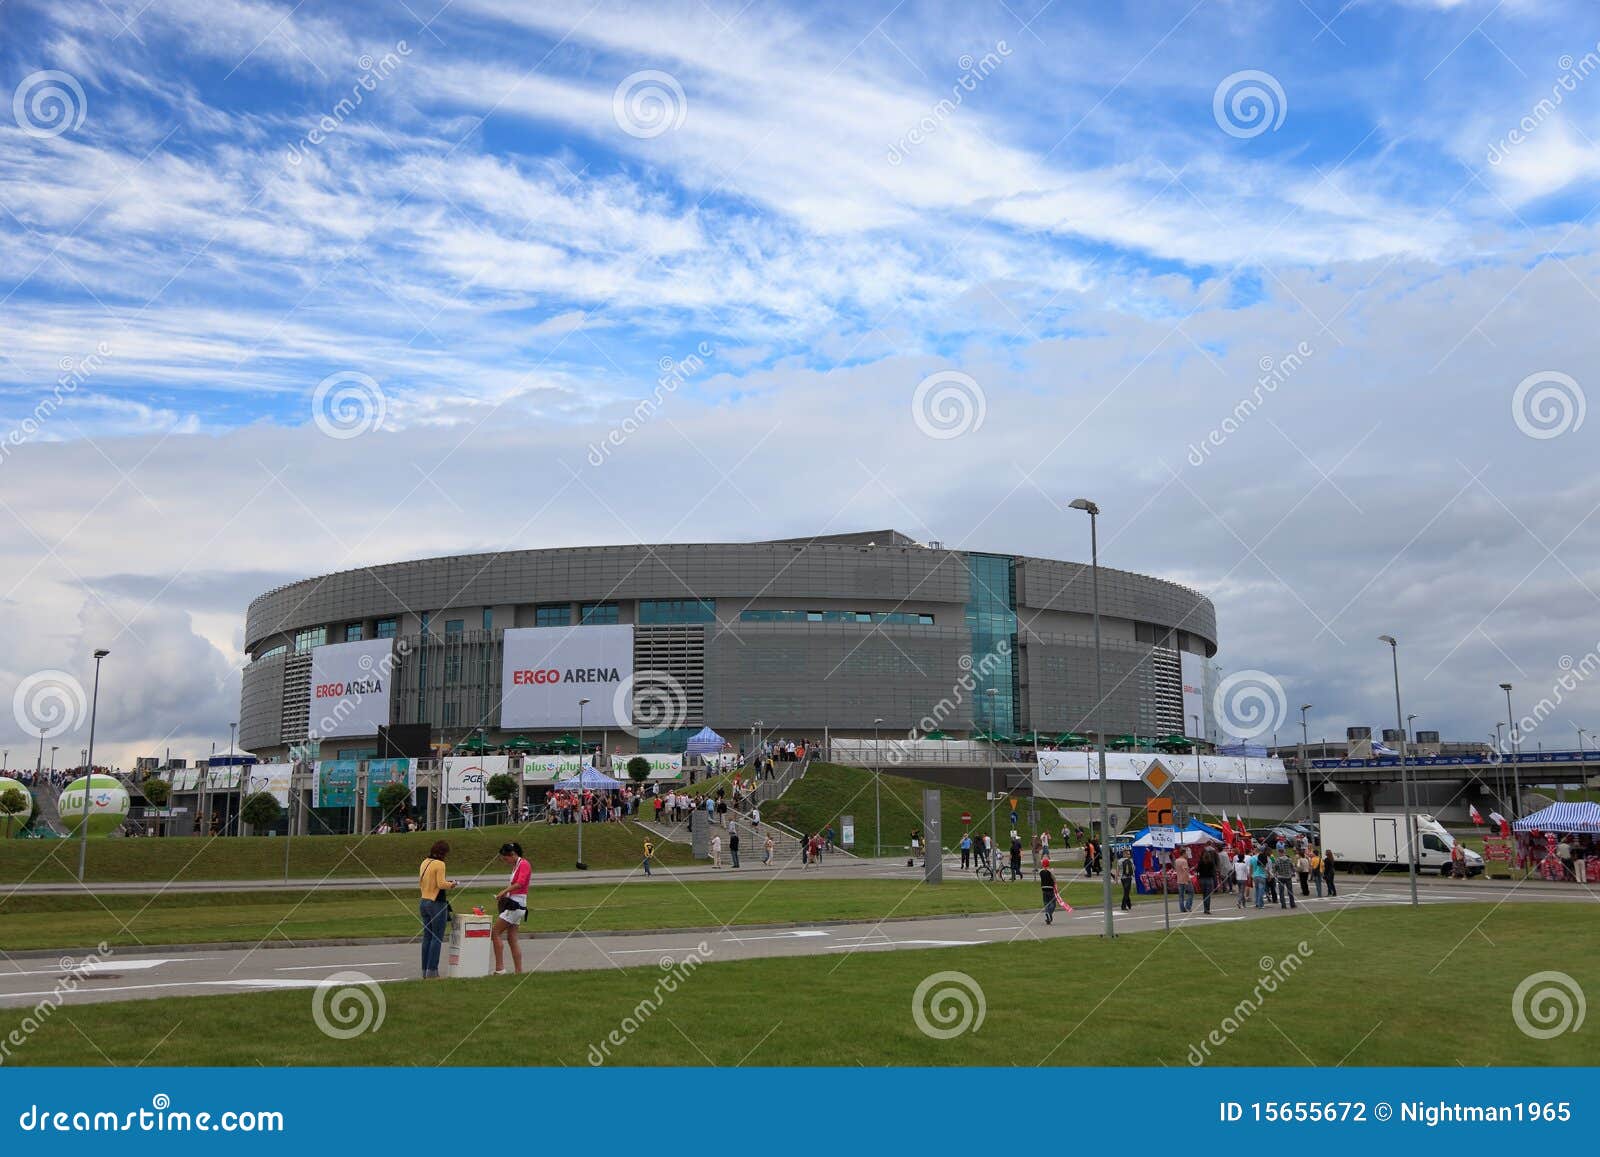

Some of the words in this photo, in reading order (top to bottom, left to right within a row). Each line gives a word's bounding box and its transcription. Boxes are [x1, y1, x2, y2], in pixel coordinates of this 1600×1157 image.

[513, 669, 560, 685] ERGO
[563, 667, 620, 683] ARENA
[316, 683, 344, 698] ERGO
[345, 680, 382, 695] ARENA
[525, 761, 547, 774] plus
